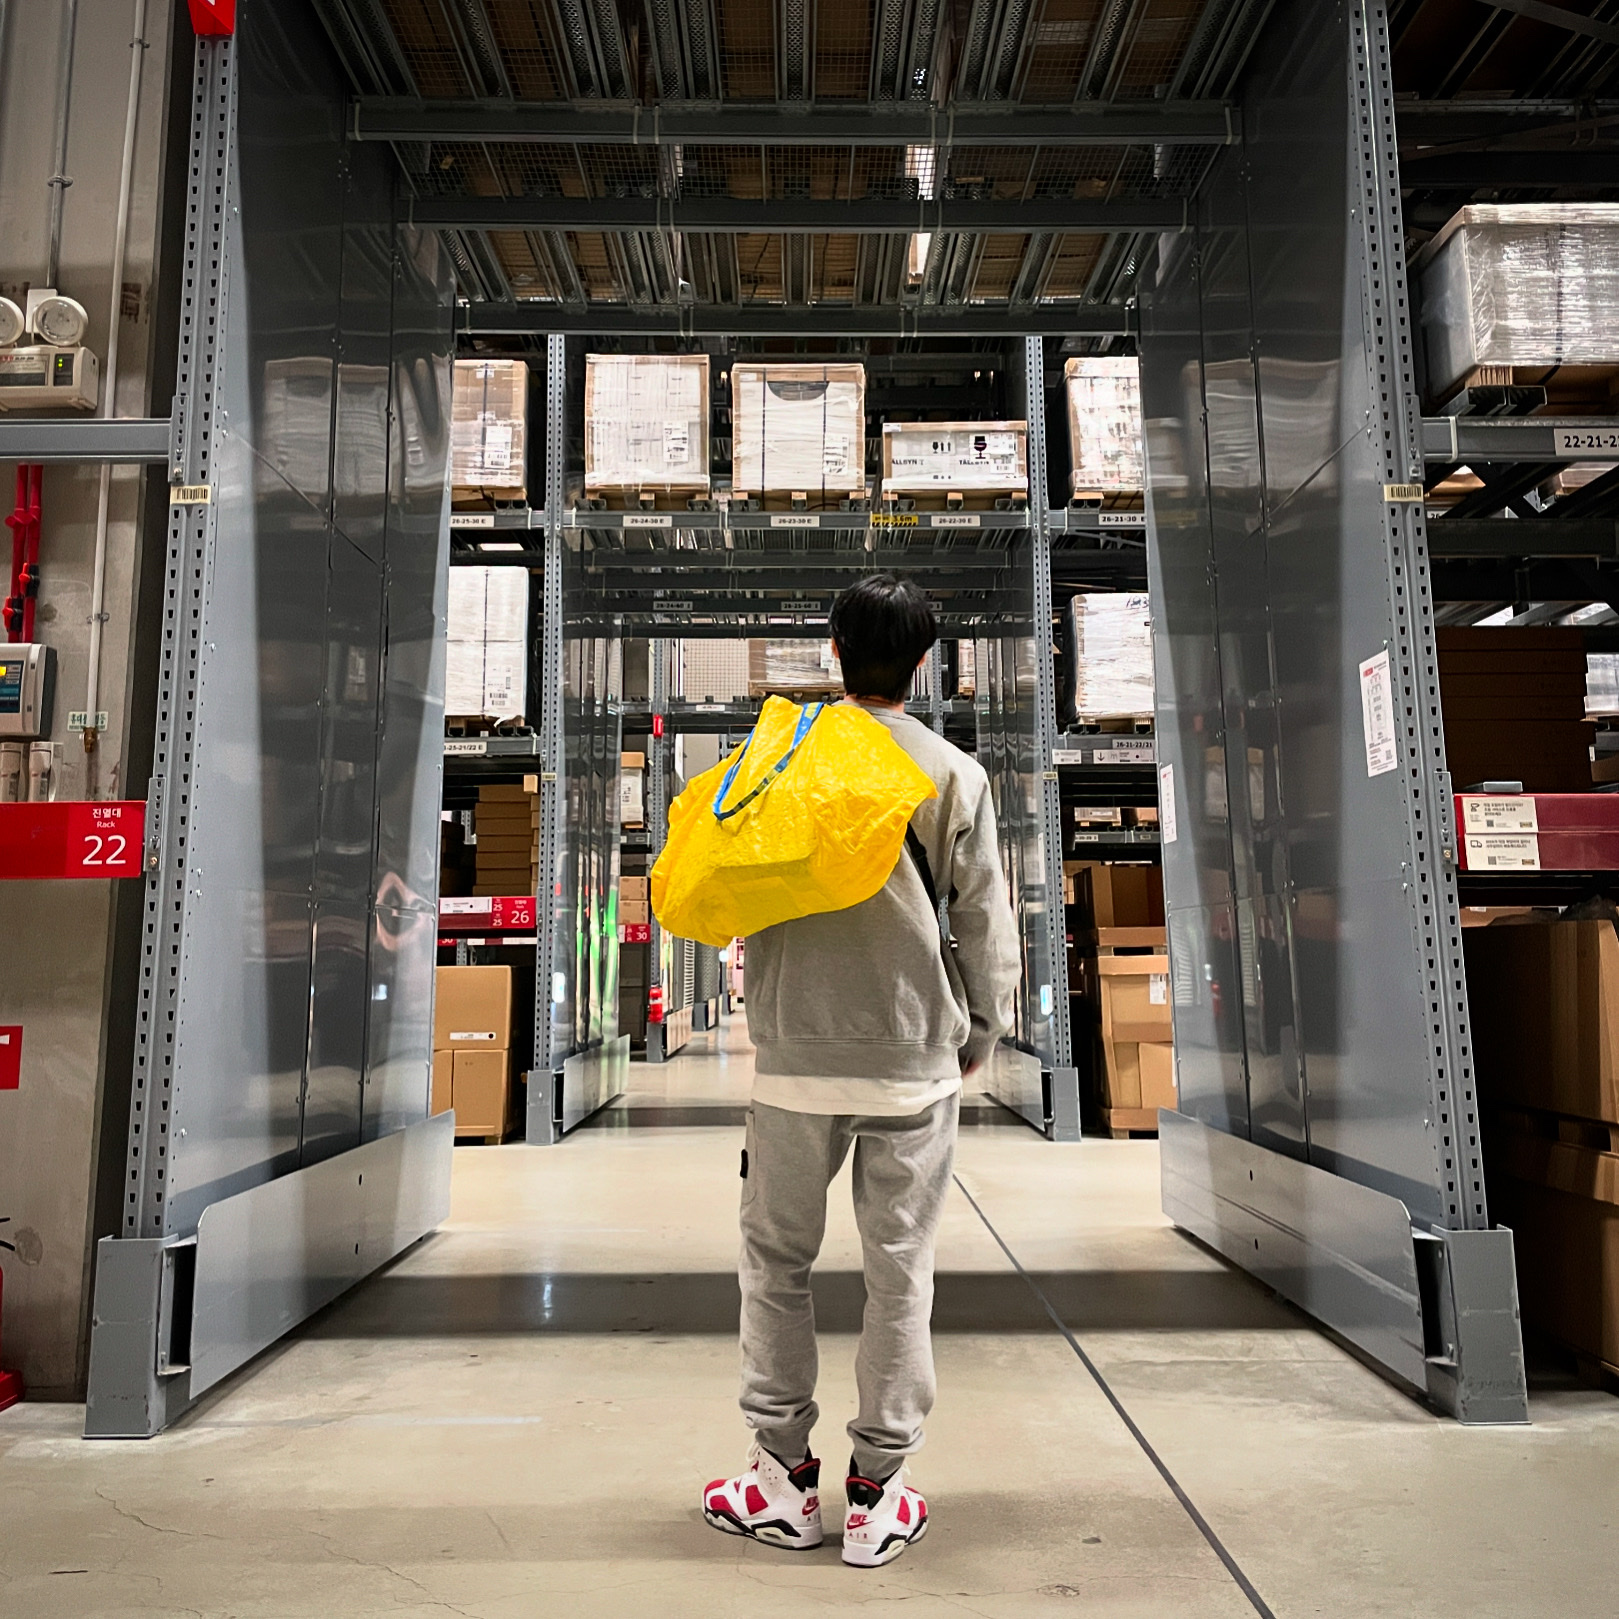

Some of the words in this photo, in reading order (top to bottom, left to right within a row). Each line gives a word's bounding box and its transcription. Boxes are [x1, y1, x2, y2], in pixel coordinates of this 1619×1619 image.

[1563, 434, 1619, 448] 22-21-2
[92, 807, 122, 819] 진열대
[96, 820, 116, 828] Rack
[82, 835, 127, 865] 22
[493, 903, 503, 912] 25
[510, 910, 530, 924] 26
[492, 918, 503, 927] 25
[636, 931, 648, 940] 30
[850, 1513, 867, 1523] NIKE
